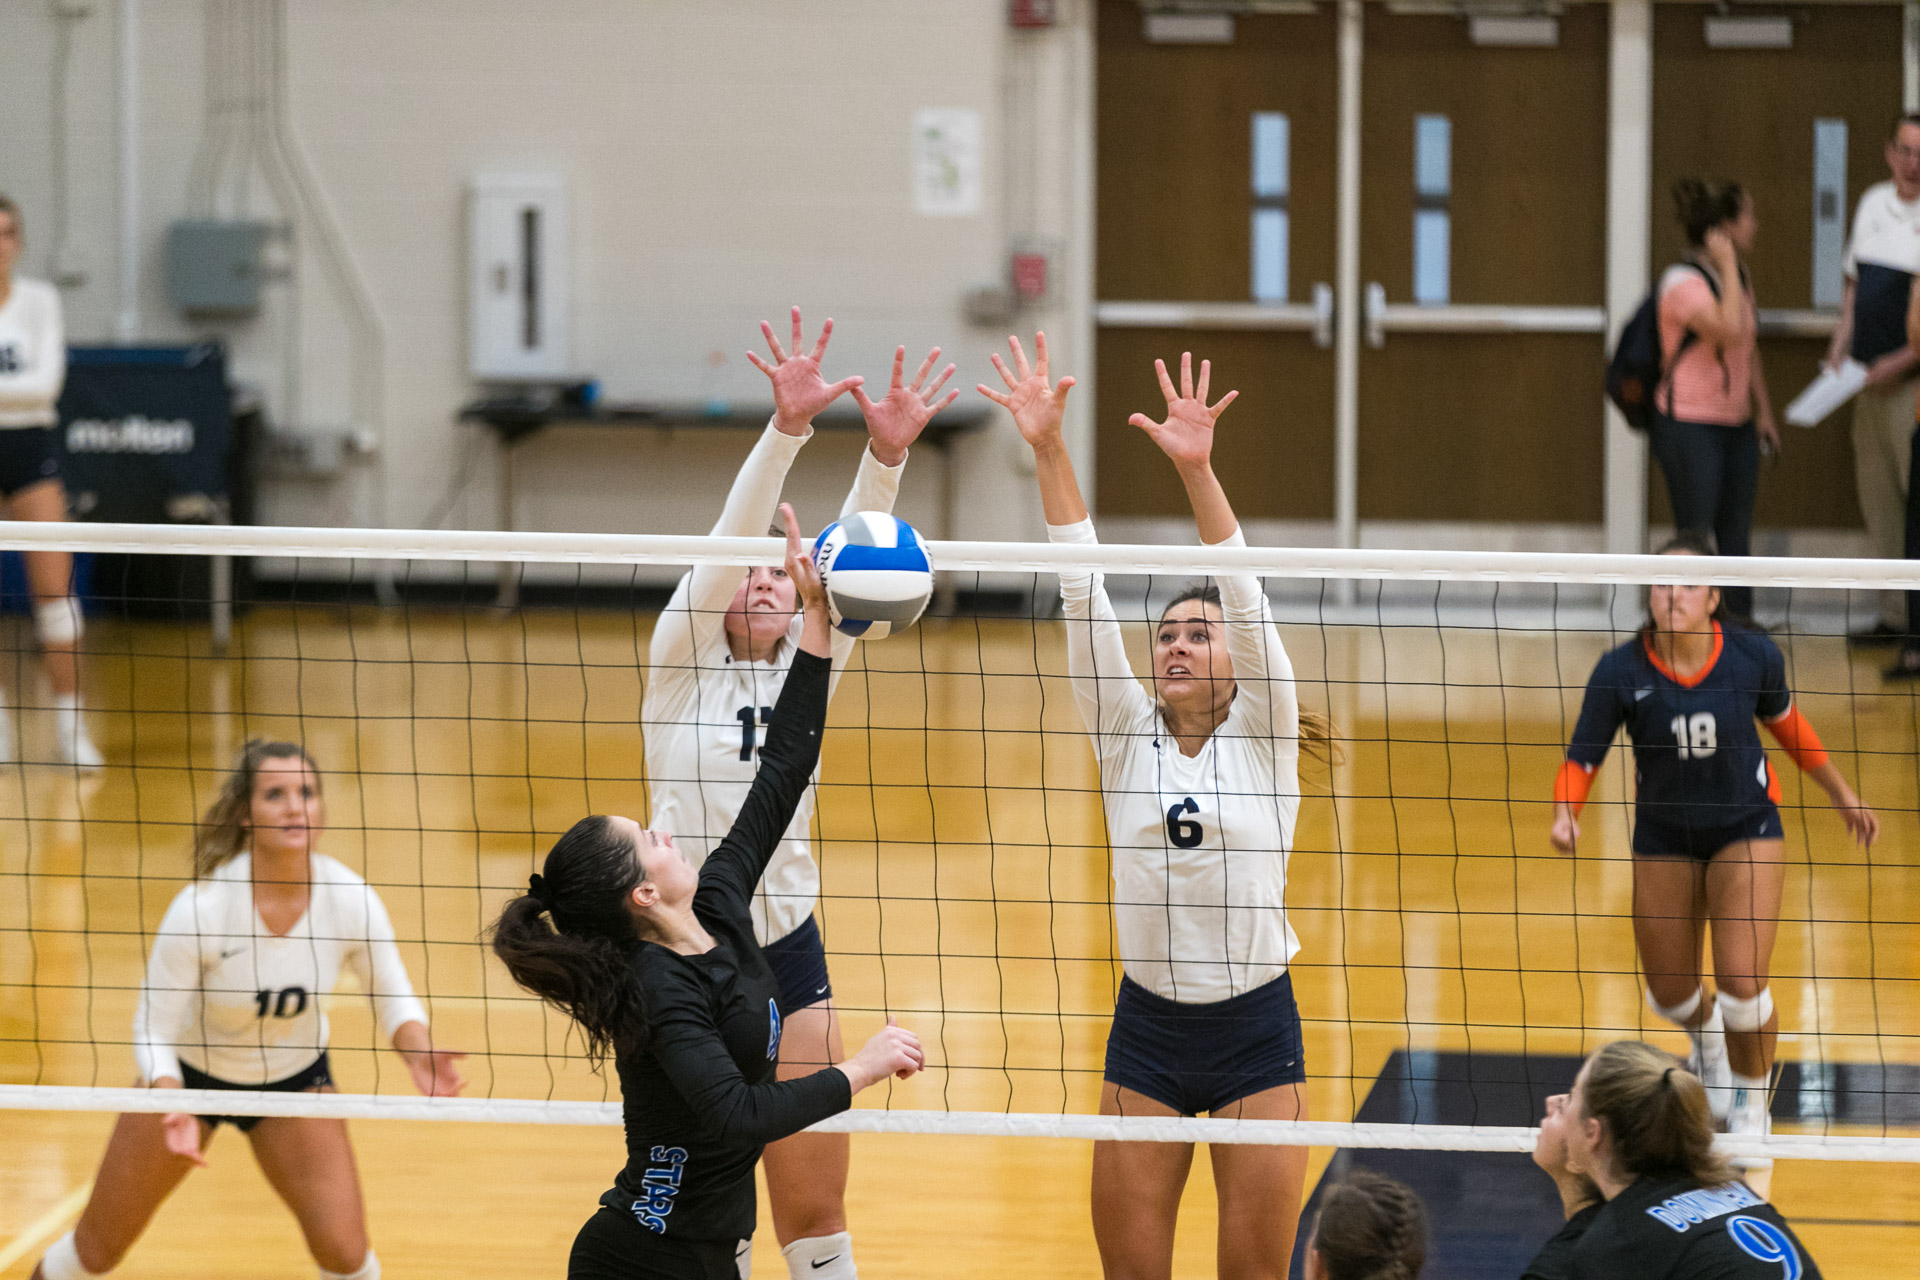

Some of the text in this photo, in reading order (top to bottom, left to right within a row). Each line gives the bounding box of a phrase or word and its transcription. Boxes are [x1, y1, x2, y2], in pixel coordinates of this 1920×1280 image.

[737, 706, 774, 761] 1
[1671, 711, 1717, 760] 18
[1166, 796, 1203, 848] 6
[256, 987, 307, 1018] 10
[631, 1145, 689, 1235] STARS
[1726, 1215, 1803, 1280] 9
